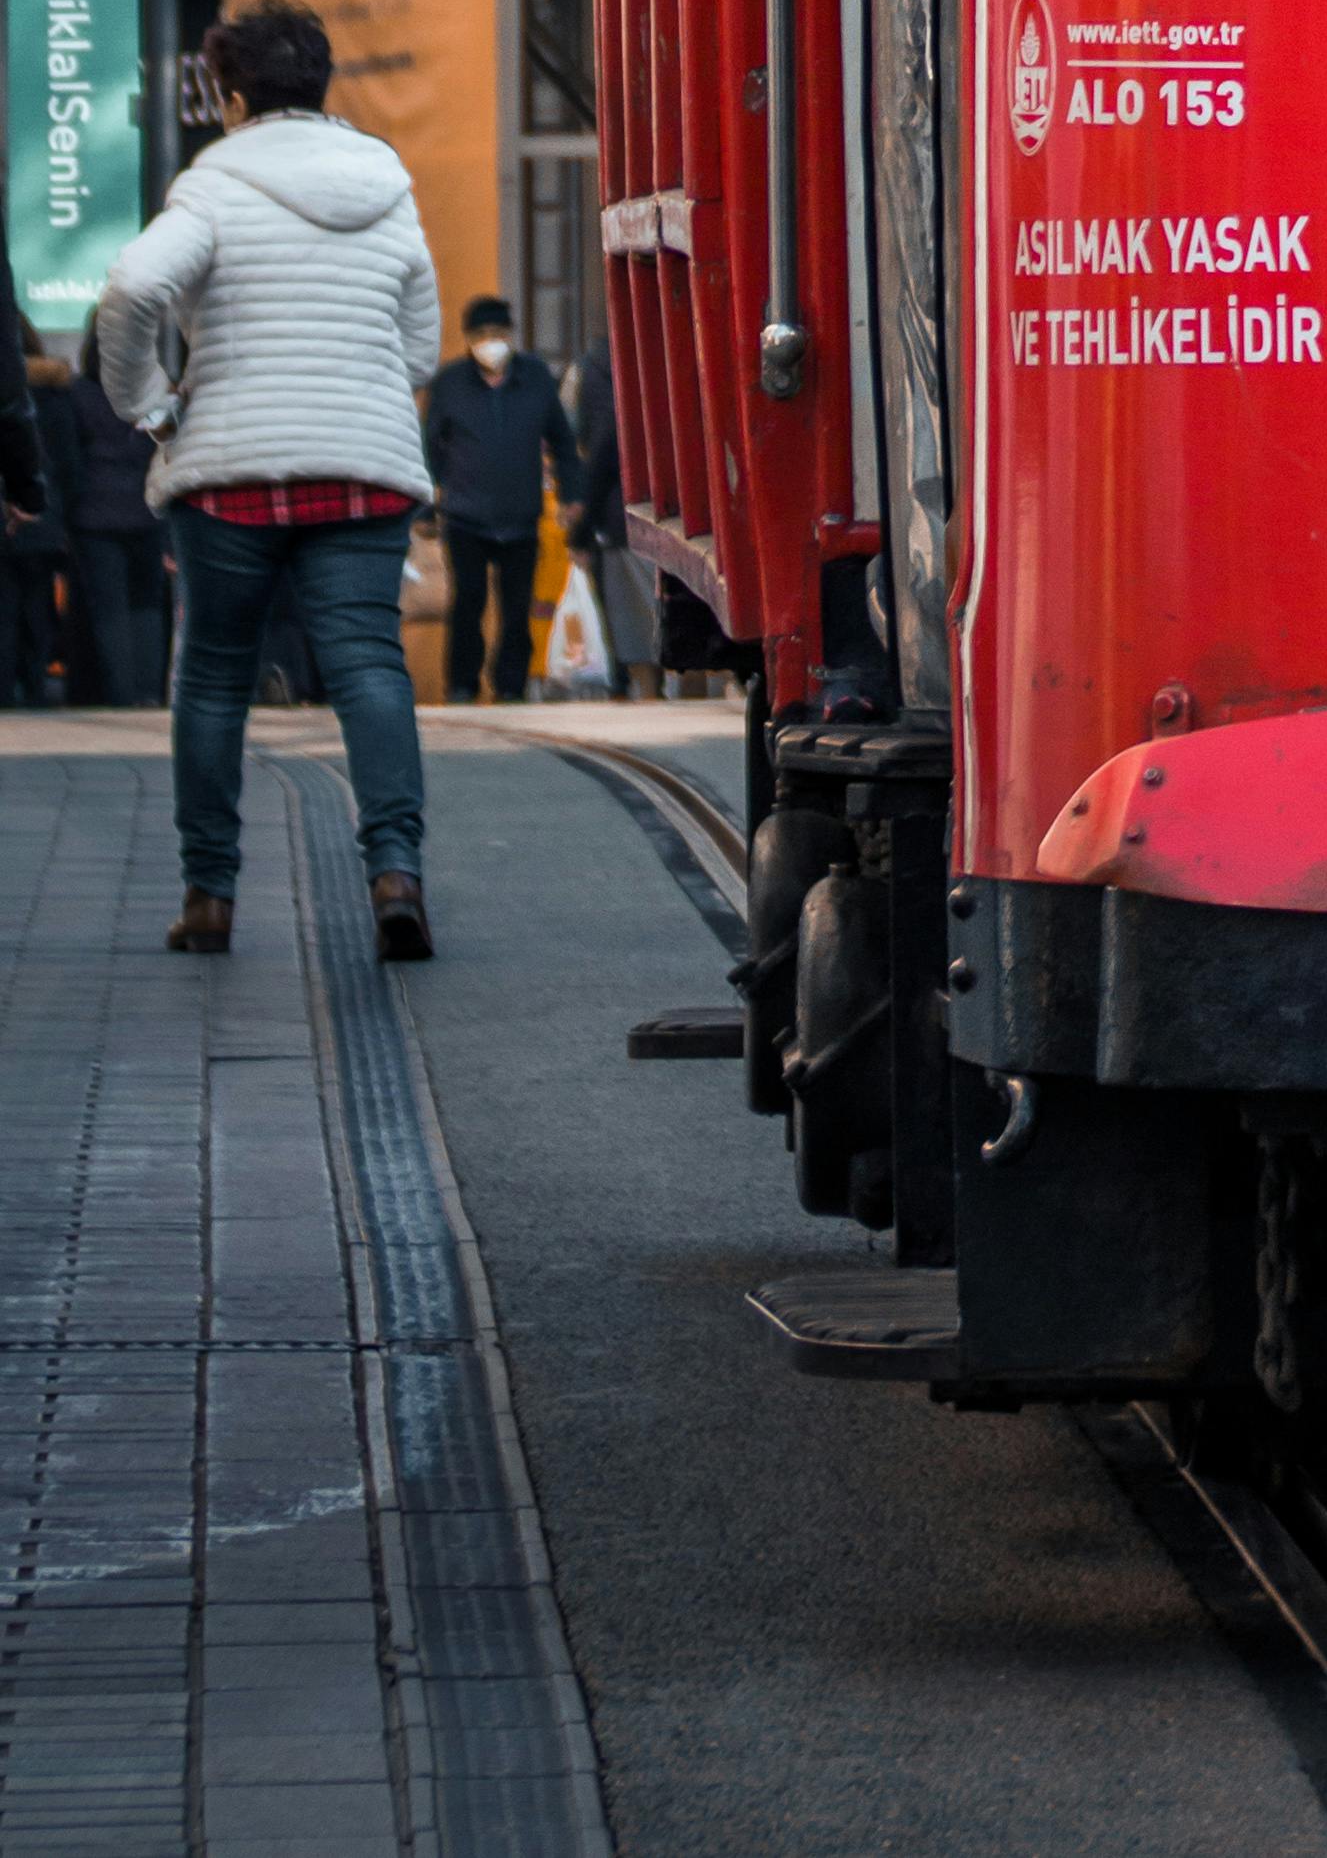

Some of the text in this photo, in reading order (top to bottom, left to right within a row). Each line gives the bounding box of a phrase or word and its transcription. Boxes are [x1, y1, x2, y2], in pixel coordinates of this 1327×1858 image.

[1066, 19, 1245, 51] www.iett.gov.tr
[1066, 79, 1245, 127] ALO 153
[1014, 214, 1311, 276] ASILMAK YASAK
[1010, 293, 1323, 366] VE TEHLİKELİDİR
